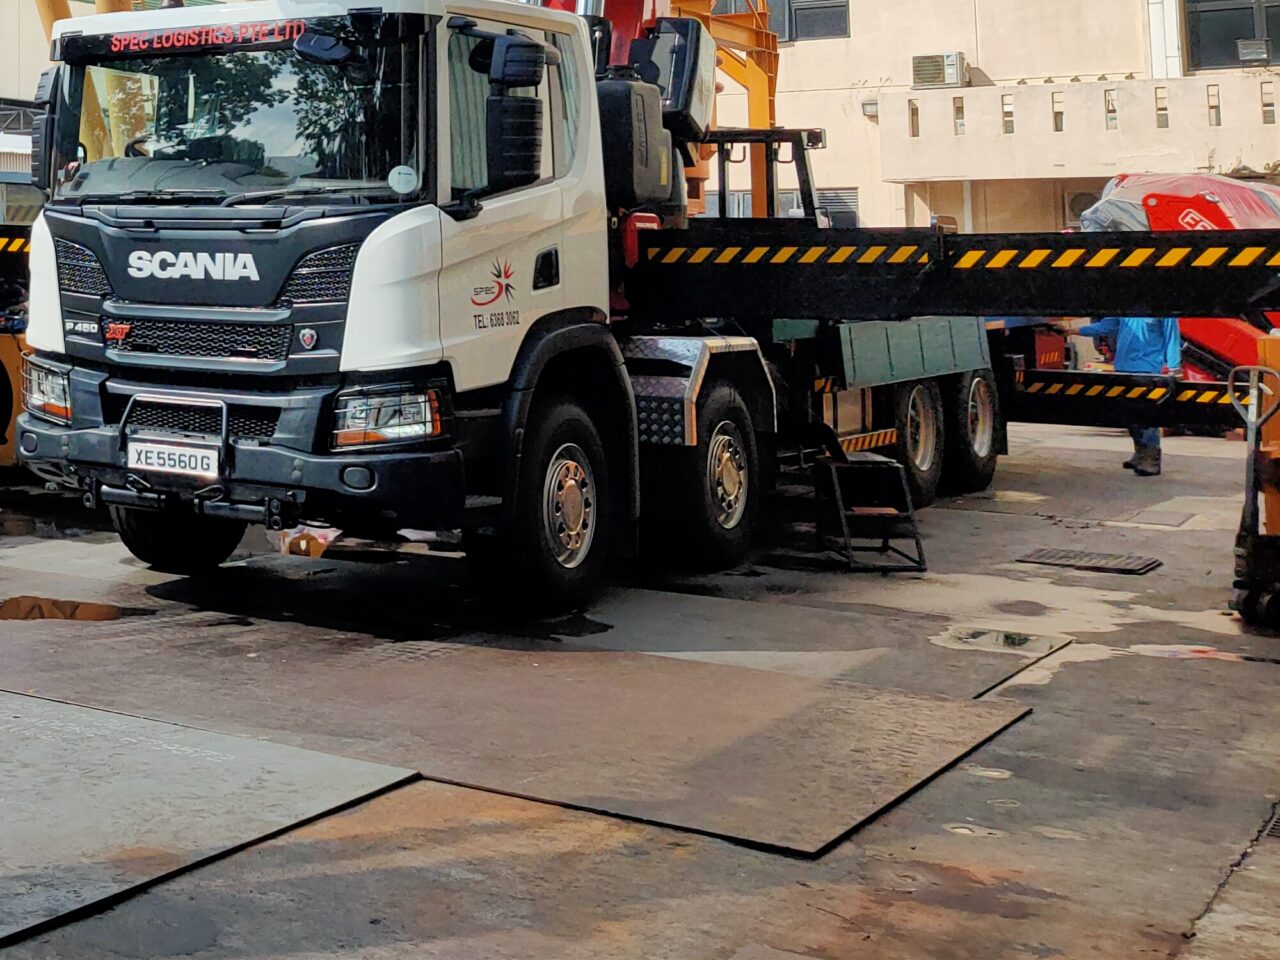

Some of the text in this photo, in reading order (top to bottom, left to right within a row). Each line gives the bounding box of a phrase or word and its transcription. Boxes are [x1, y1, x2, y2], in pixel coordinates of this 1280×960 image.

[111, 20, 305, 52] SPEC LOGISTICS PTE LTD
[127, 250, 260, 281] SCANIA
[473, 286, 496, 296] SPEC
[65, 322, 98, 333] P 450
[473, 313, 489, 330] TEL:
[106, 323, 131, 340] XT
[135, 448, 210, 471] XE5560G
